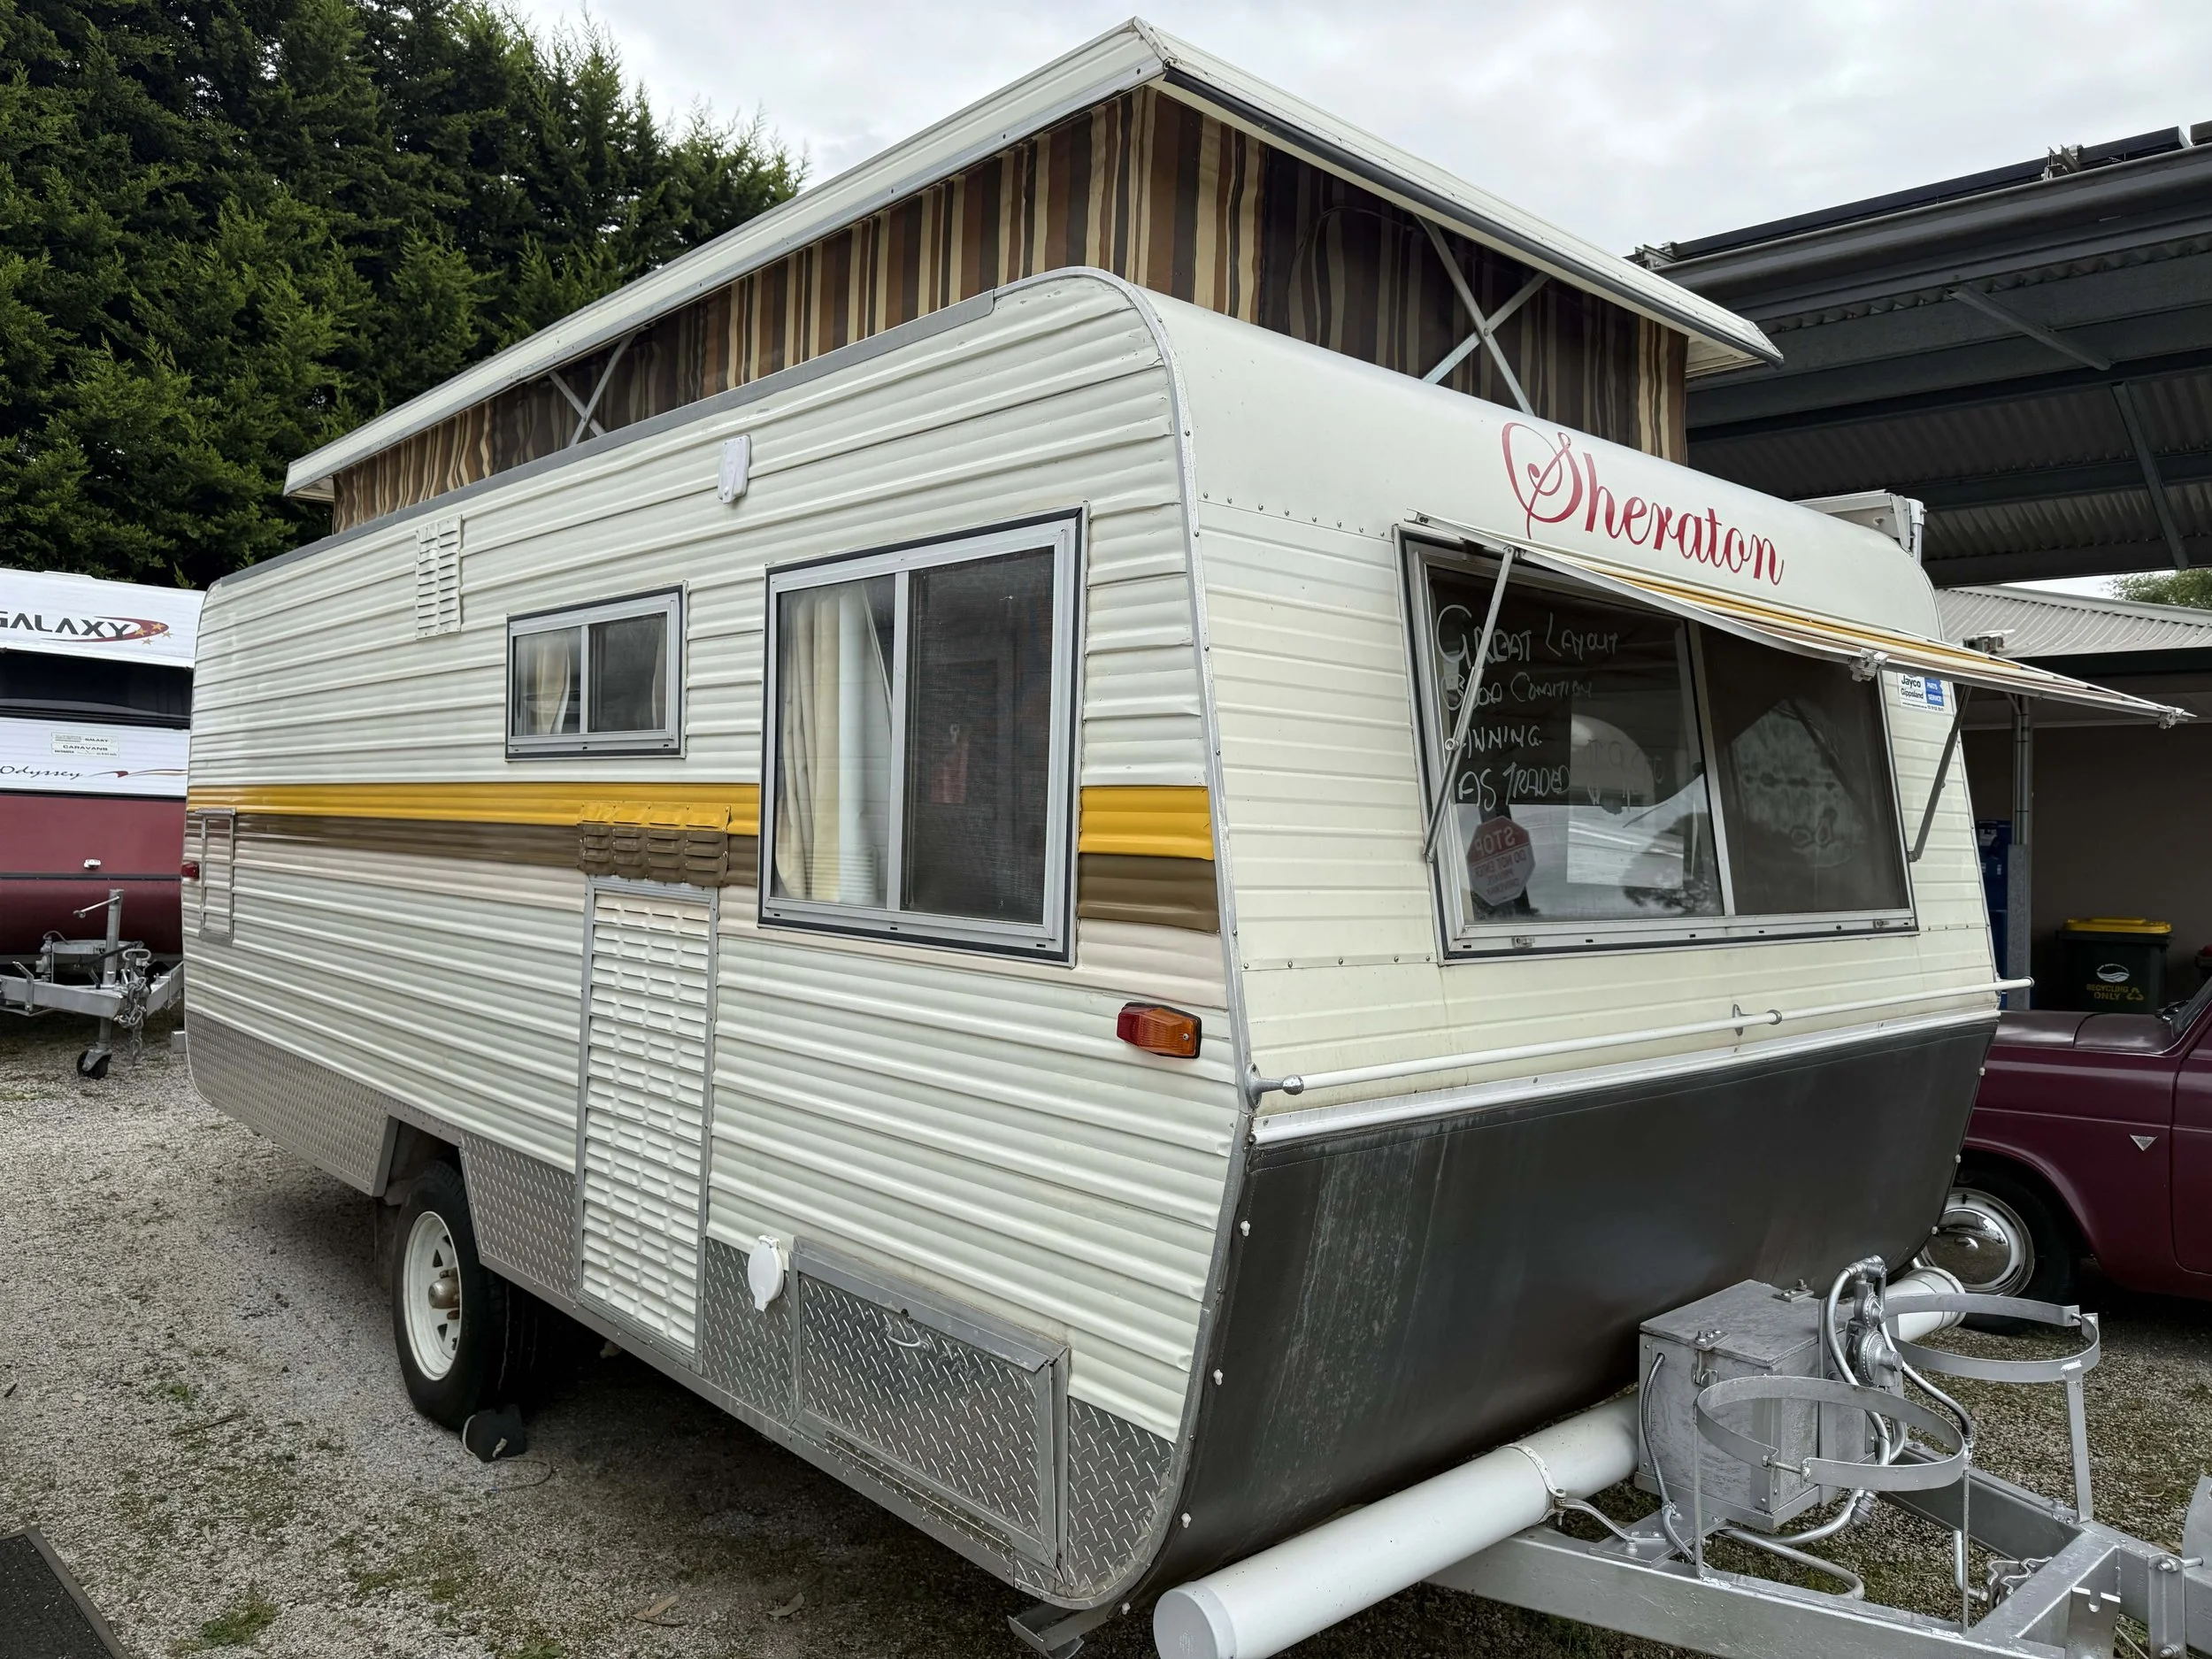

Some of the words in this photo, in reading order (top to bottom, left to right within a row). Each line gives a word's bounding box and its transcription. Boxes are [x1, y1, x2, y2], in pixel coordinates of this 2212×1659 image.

[1502, 422, 1785, 586] Sheraton
[1546, 612, 1619, 661] LAYOUT
[1901, 675, 1921, 688] Jayco
[1440, 672, 1503, 711] GOD
[1901, 688, 1924, 699] Gippsland
[0, 765, 83, 780] Odyssey
[1458, 768, 1497, 812] AS
[2086, 984, 2129, 993] RECYCLING
[2093, 992, 2120, 1001] ONLY
